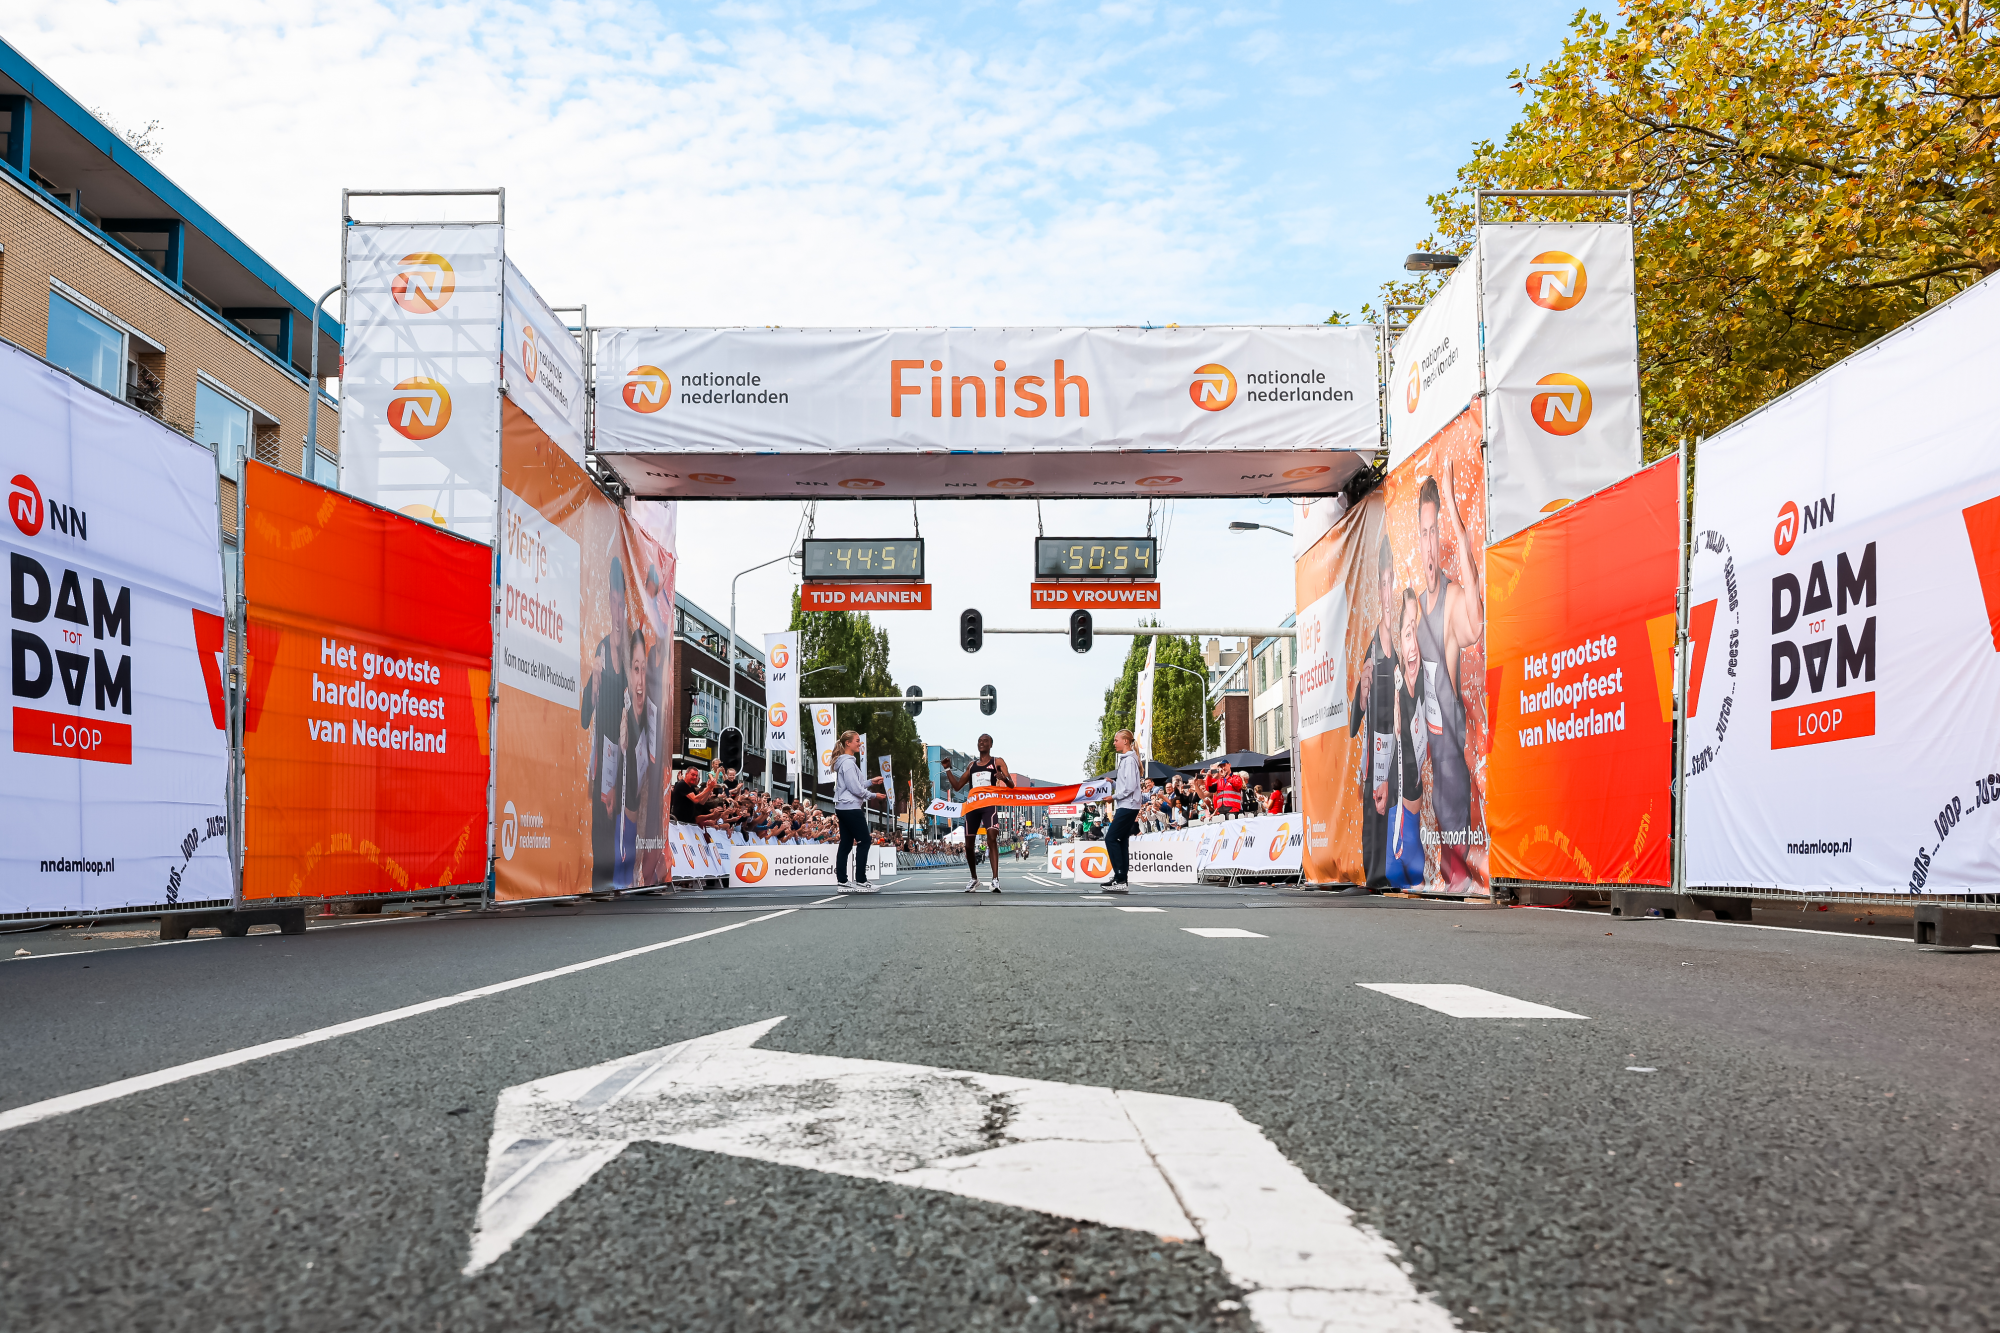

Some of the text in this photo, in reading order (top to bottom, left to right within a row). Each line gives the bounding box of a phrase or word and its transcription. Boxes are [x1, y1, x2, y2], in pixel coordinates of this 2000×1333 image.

[538, 350, 563, 383] nationale
[681, 371, 761, 387] nationale
[1247, 368, 1326, 385] nationale
[538, 370, 569, 409] nederlanden
[681, 389, 789, 405] nederlanden
[890, 359, 1090, 418] Finish
[1247, 386, 1354, 402] nederlanden
[48, 498, 87, 541] NN
[1803, 493, 1835, 534] NN
[507, 508, 547, 584] Vier je
[10, 551, 131, 647] DAM
[810, 591, 923, 604] TIJD MANNEN
[1033, 589, 1159, 603] TIJD VROUWEN
[1771, 541, 1877, 636] DAM
[505, 583, 563, 644] prestatie
[1808, 619, 1826, 635] TOT
[62, 629, 83, 646] TOT
[321, 637, 441, 686] Het grootste
[517, 657, 530, 674] naar
[1523, 634, 1617, 681] Het grootste
[1727, 628, 1739, 678] feest
[1771, 615, 1877, 702] DAM
[11, 628, 132, 716] DAM
[1299, 650, 1335, 705] prestatie
[312, 672, 445, 720] hardloopfeest
[1520, 667, 1623, 715] hardloopfeest
[52, 723, 102, 750] LOOP
[308, 718, 447, 754] van Nederland
[1518, 701, 1626, 748] van Nederland
[1798, 708, 1843, 737] LOOP
[1692, 744, 1714, 776] Start
[978, 792, 999, 801] DAM
[1015, 792, 1057, 800] DAMLOOP
[1096, 786, 1108, 794] NN
[1289, 834, 1304, 847] NN
[1420, 826, 1441, 845] Onze
[1441, 826, 1467, 848] sport
[1787, 838, 1852, 857] nndamloop.nl
[40, 857, 115, 876] nndamloop.nl
[774, 853, 829, 865] nationale
[774, 864, 838, 876] nederlande
[1128, 850, 1173, 861] ationale
[1128, 862, 1193, 873] ederlanden
